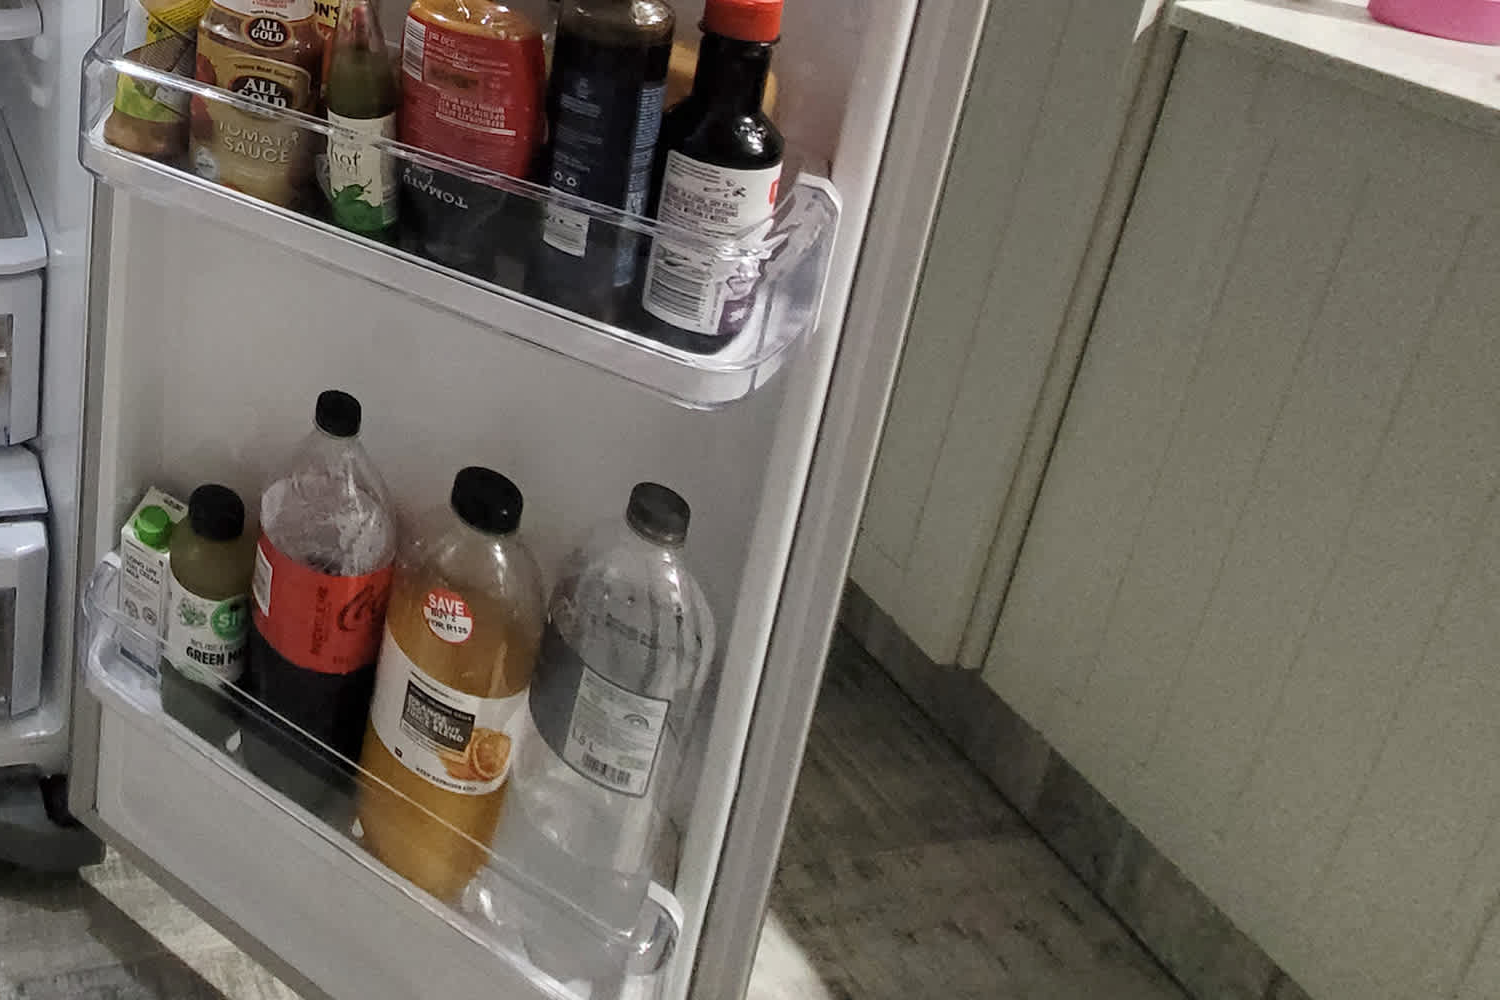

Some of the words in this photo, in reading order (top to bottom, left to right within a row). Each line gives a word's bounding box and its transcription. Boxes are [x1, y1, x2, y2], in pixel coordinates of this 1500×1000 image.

[250, 28, 285, 42] GOLD
[255, 18, 281, 32] ALL
[244, 77, 281, 97] ALL
[224, 136, 292, 164] SAUCE
[428, 592, 464, 617] SAVE
[186, 645, 225, 667] GREEN
